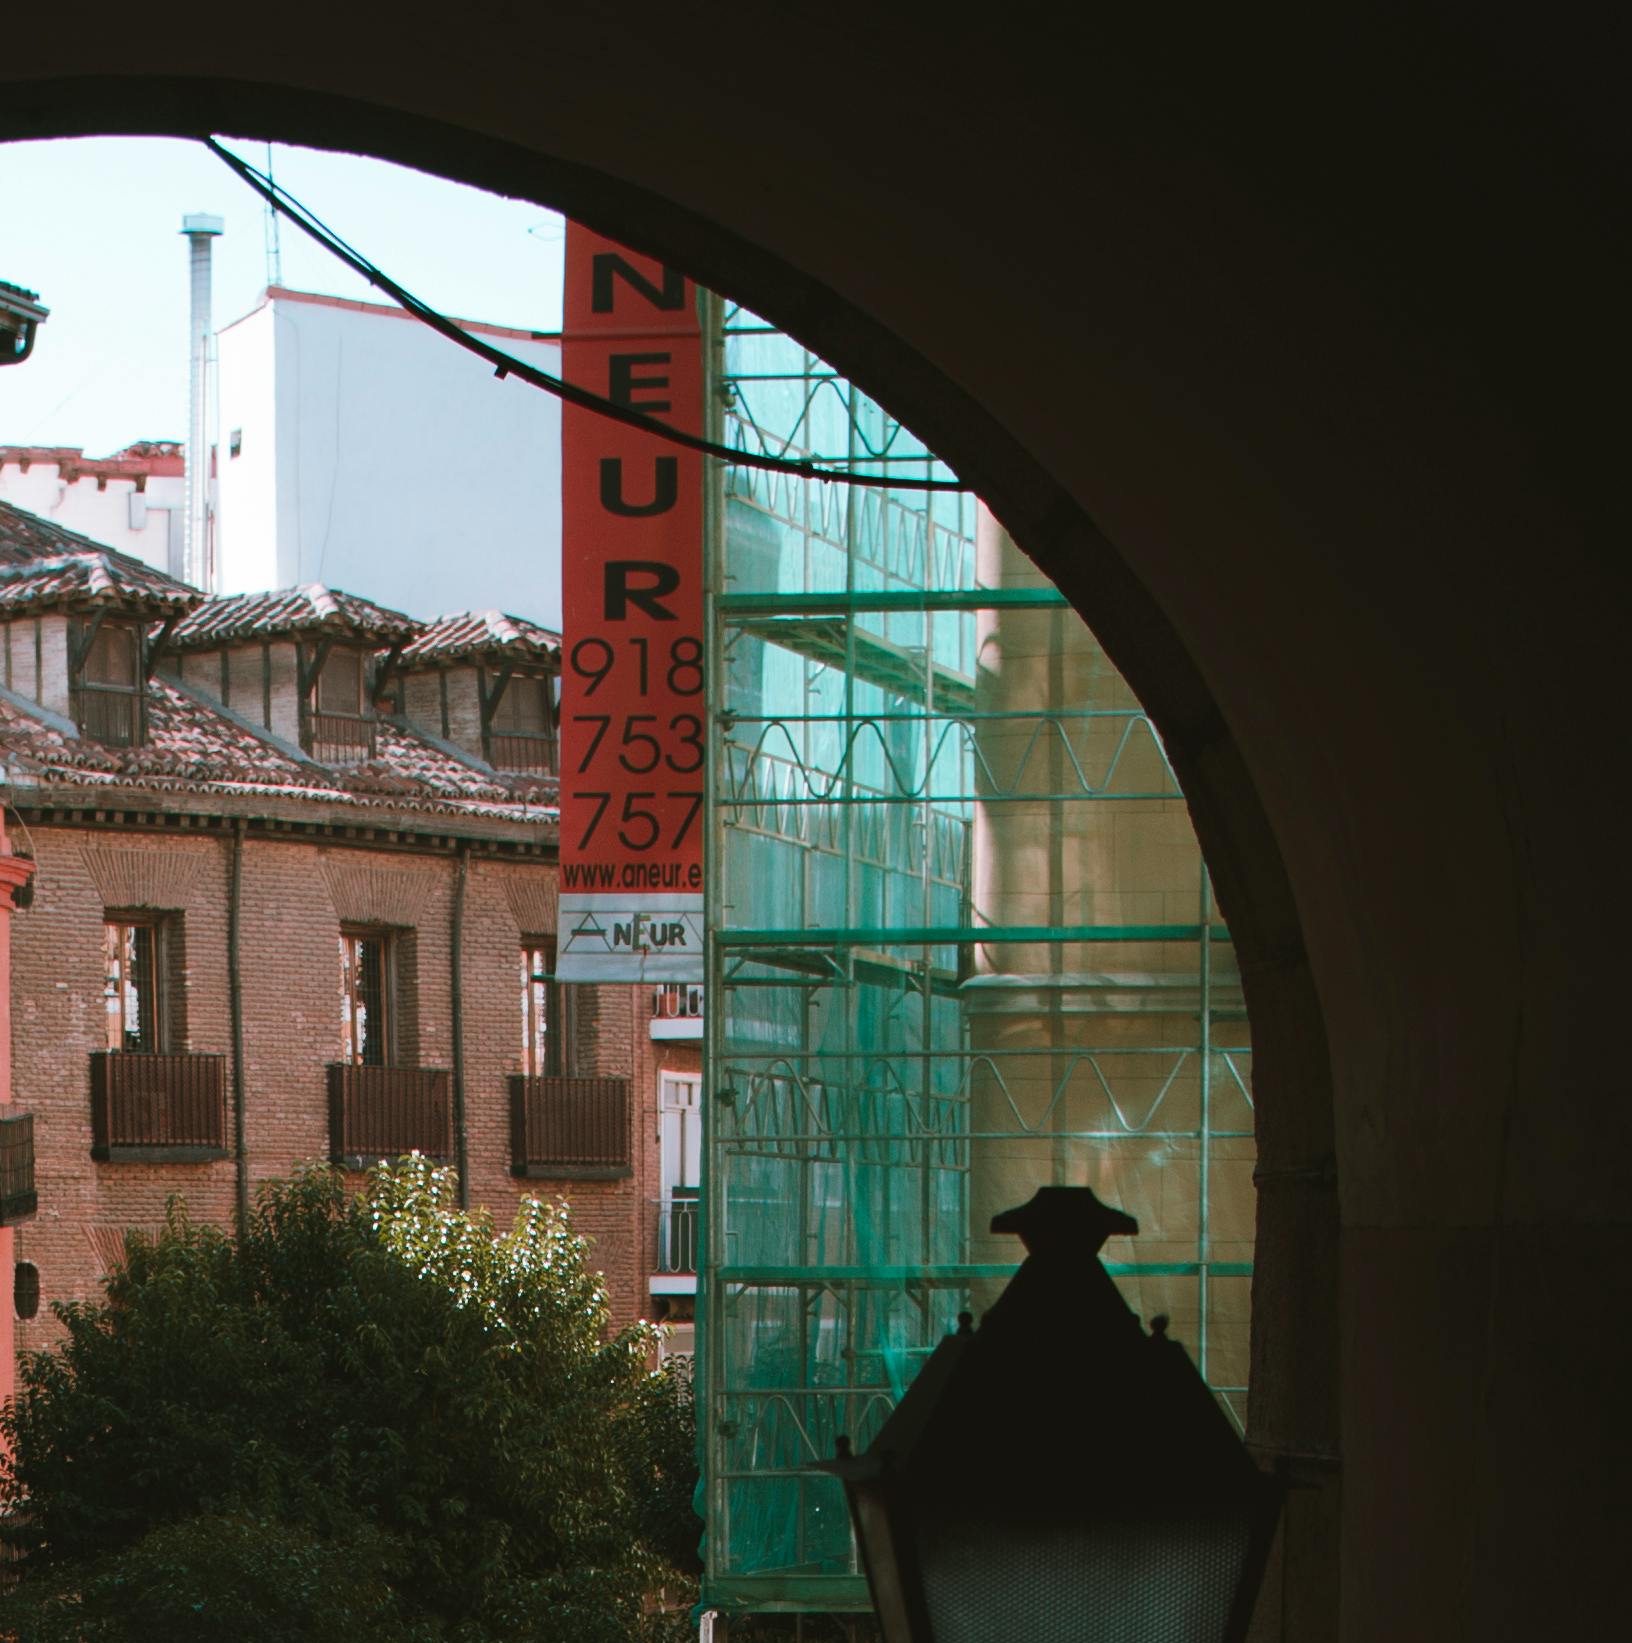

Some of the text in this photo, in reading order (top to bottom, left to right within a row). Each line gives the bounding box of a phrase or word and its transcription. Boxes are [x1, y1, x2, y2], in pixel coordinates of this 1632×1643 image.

[570, 636, 705, 697] 918
[572, 713, 705, 774] 753
[572, 792, 704, 850] 757
